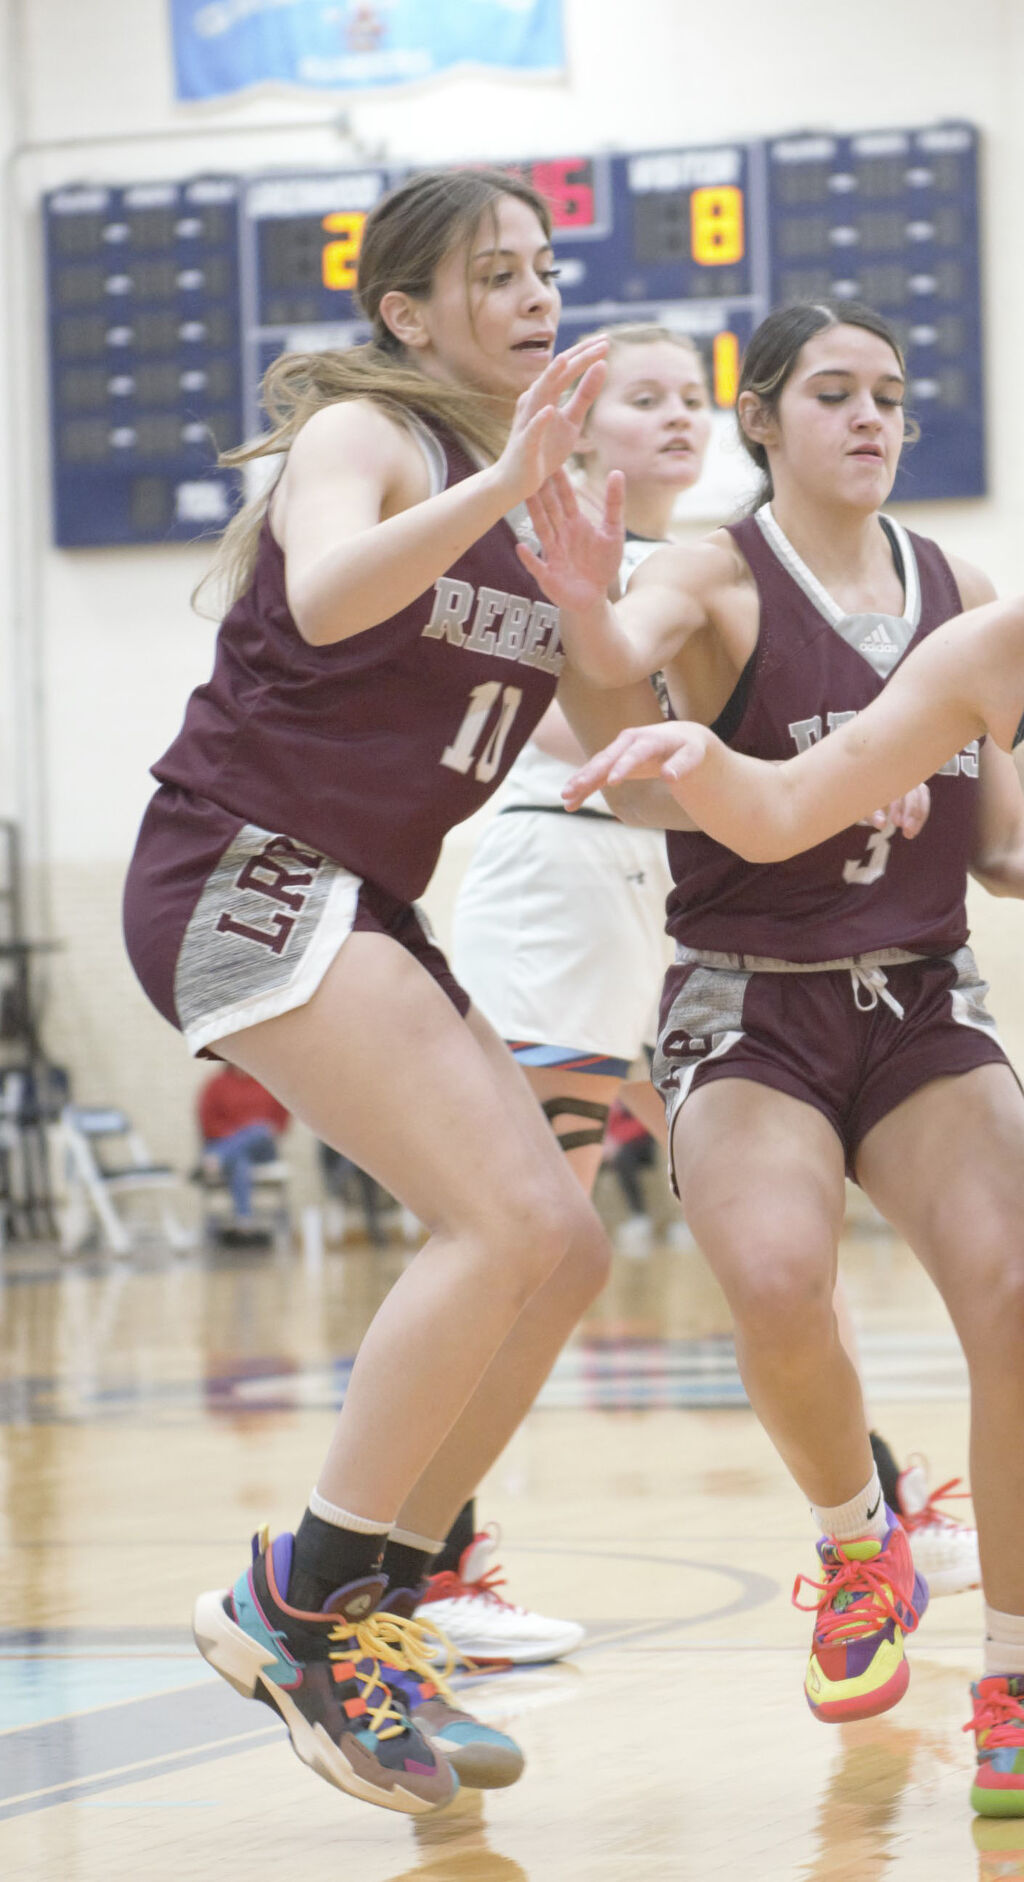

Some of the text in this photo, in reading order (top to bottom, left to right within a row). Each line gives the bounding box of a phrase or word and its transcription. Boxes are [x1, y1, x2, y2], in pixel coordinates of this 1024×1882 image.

[321, 210, 369, 291] 2
[691, 185, 745, 266] 8
[713, 331, 739, 408] 1
[842, 817, 898, 886] 3
